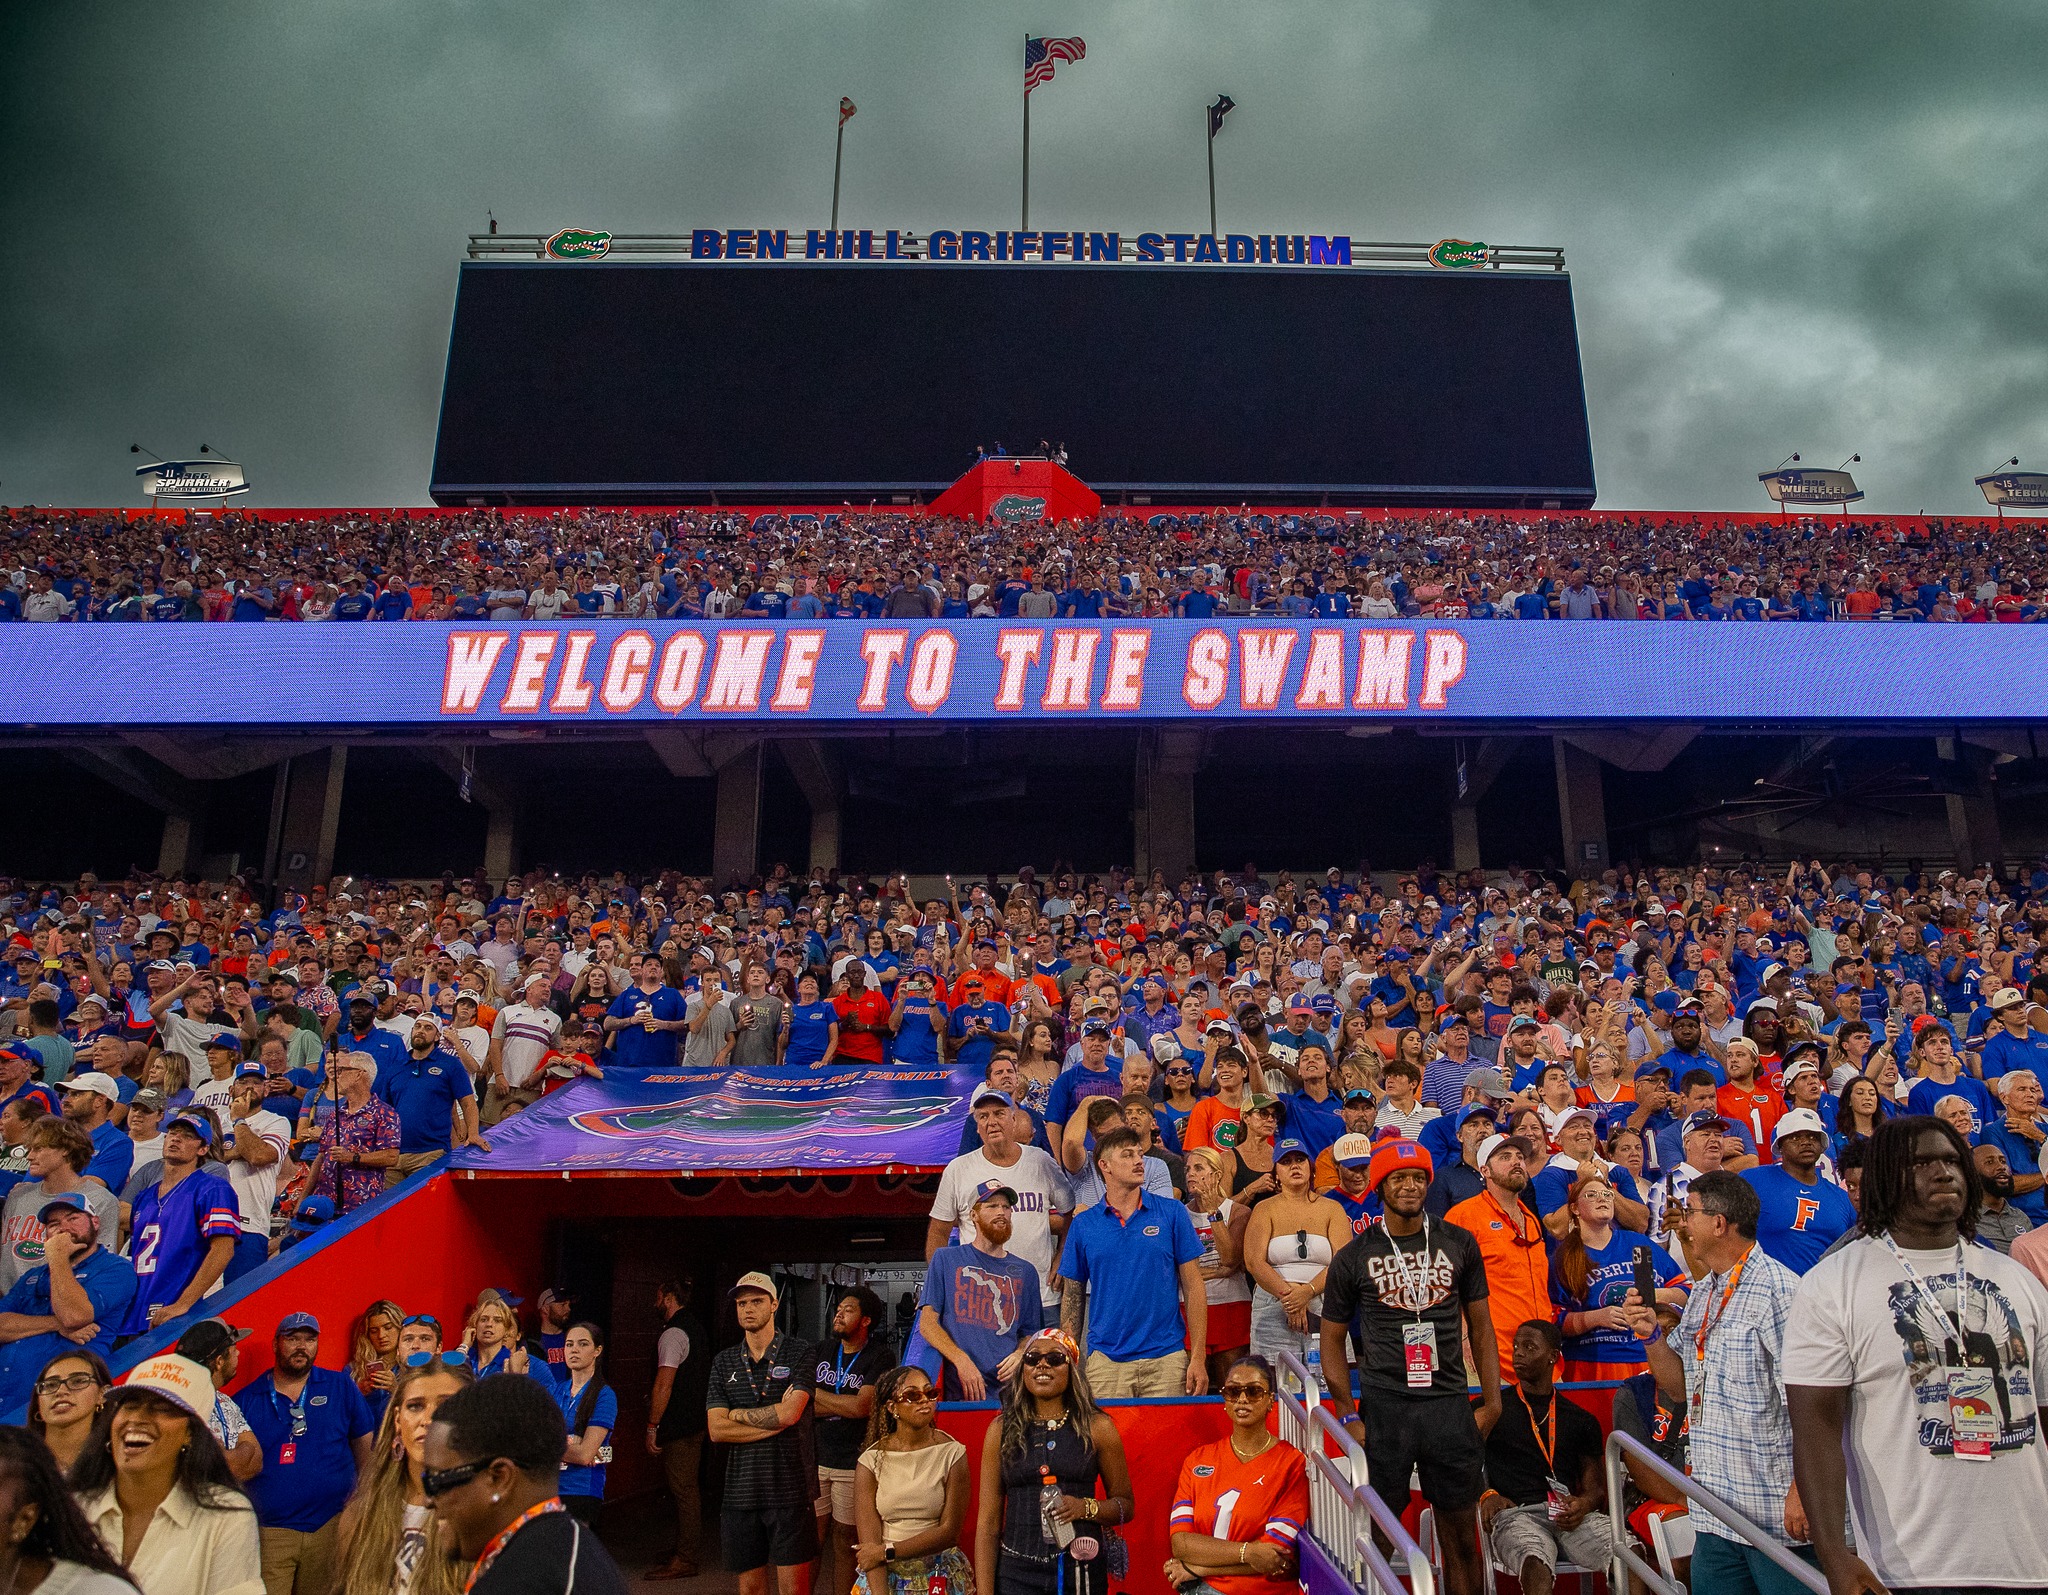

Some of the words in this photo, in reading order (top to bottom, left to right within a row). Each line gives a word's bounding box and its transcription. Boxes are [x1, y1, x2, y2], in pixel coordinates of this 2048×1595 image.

[691, 229, 788, 260] BEN
[805, 229, 911, 260] HILL
[927, 230, 1121, 263] GRIFFIN
[1137, 232, 1352, 266] STADIUM
[156, 479, 228, 487] SPURRIER
[1788, 476, 1794, 484] 7
[2003, 480, 2013, 488] 15
[1781, 485, 1847, 494] WUERFFEL
[1329, 598, 1337, 612] 1
[440, 628, 827, 716] WELCOME
[857, 627, 958, 716] TO
[994, 627, 1152, 712] THE
[1182, 626, 1469, 712] SWAMP
[1585, 843, 1599, 860] E
[288, 853, 307, 870] D
[1545, 967, 1573, 981] BULLS
[1963, 983, 1972, 995] 11
[902, 1004, 931, 1015] FLORID
[964, 1016, 993, 1027] Gatrs
[641, 1071, 725, 1085] BRYAN
[863, 1069, 957, 1082] FAMILY
[725, 1080, 802, 1092] LOCKER
[804, 1079, 867, 1091] ROOM
[1749, 1107, 1764, 1145] 1
[851, 1151, 897, 1160] JR
[1343, 1141, 1354, 1156] GO
[1354, 1139, 1370, 1155] GAT
[1644, 1127, 1661, 1170] 1
[1010, 1191, 1044, 1213] RIDA
[1789, 1196, 1821, 1232] F
[3, 1214, 48, 1245] FLOR
[135, 1222, 162, 1277] 2
[1368, 1249, 1454, 1278] COCOA
[1903, 1262, 1915, 1277] Gators
[894, 1270, 906, 1280] '95
[911, 1270, 924, 1280] '96
[1374, 1266, 1453, 1294] TIGERS
[1921, 1287, 1933, 1302] Gators
[1939, 1314, 1951, 1331] Gators
[151, 1362, 185, 1376] WON'T
[160, 1371, 192, 1390] DOWN
[1920, 1418, 1954, 1447] Jak
[1989, 1426, 2035, 1447] immons
[1213, 1487, 1242, 1540] 1
